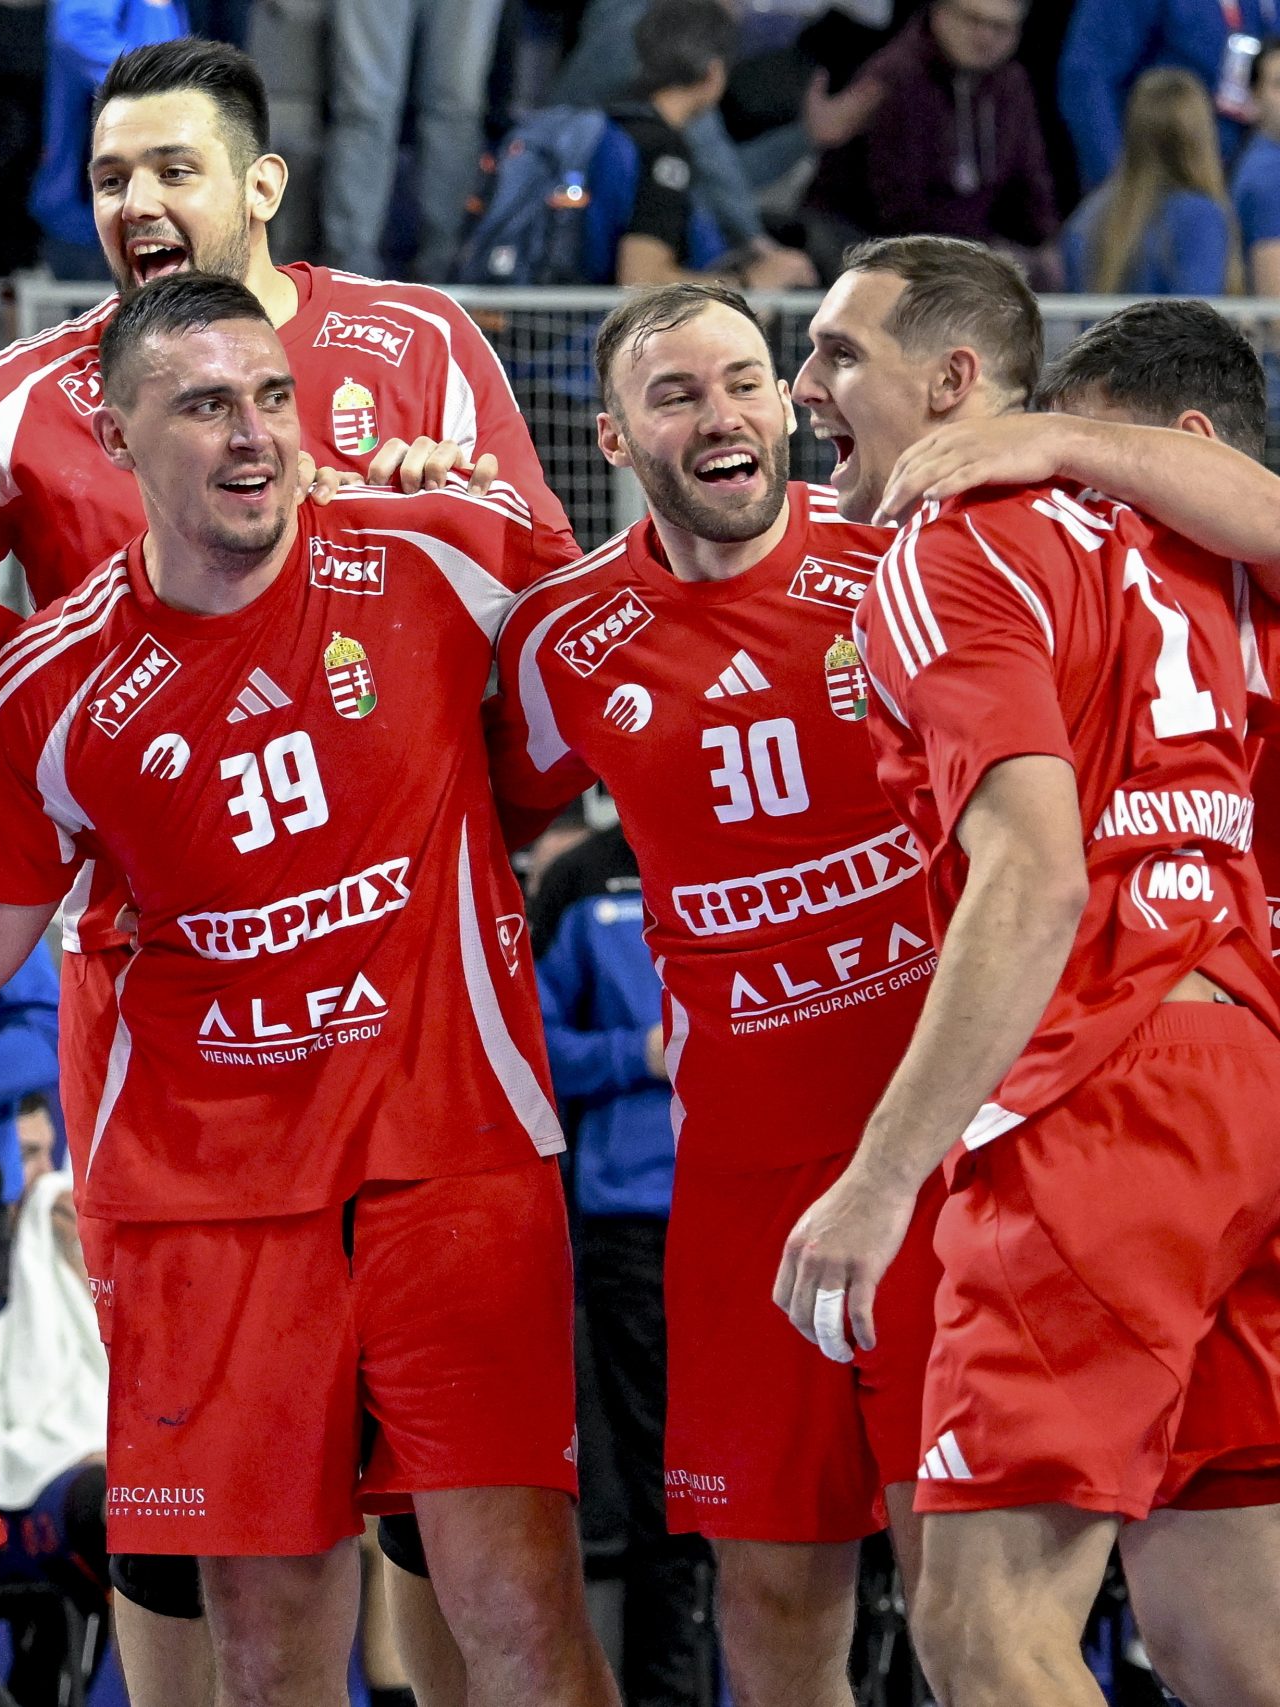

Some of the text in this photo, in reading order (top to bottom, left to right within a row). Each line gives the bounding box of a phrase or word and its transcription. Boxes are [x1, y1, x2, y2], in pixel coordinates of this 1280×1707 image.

[336, 324, 404, 356] JYSK
[320, 554, 380, 583] JYSK
[814, 574, 868, 600] JYS
[580, 600, 643, 656] JYSK
[112, 648, 171, 715] JYSK
[220, 730, 330, 854] 39
[701, 717, 810, 824] 30
[1147, 861, 1215, 902] MOL
[731, 922, 927, 1009] ALFA
[198, 971, 387, 1038] ALFA
[731, 956, 939, 1035] VIENNA INSURANCE GROUP
[200, 1023, 382, 1066] VIENNA INSURNCE GROU
[110, 1508, 206, 1516] EET SOLUTION
